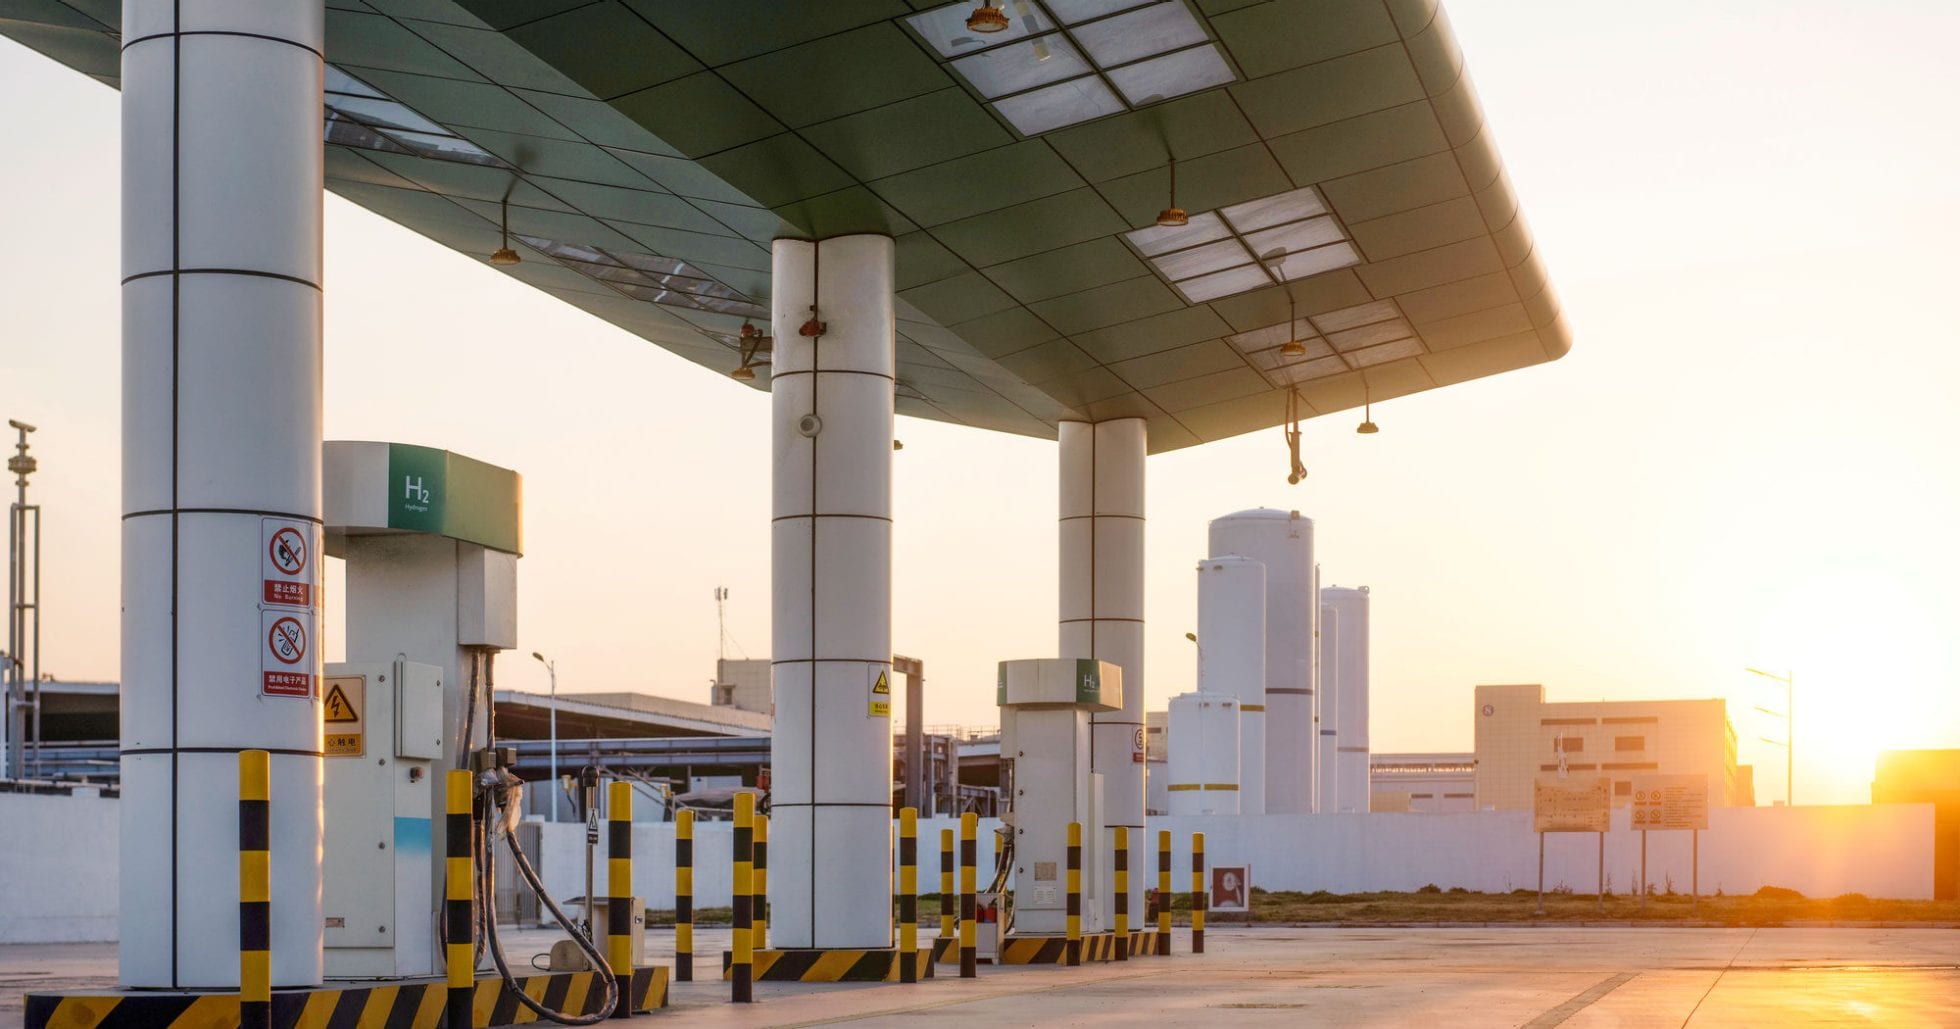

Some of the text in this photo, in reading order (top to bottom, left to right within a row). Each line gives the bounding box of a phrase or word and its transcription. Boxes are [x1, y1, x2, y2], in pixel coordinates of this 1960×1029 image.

[405, 475, 429, 504] H2
[274, 583, 304, 595] 禁止烟火
[268, 674, 307, 685] 禁用电子产品
[328, 737, 356, 747] 心触电
